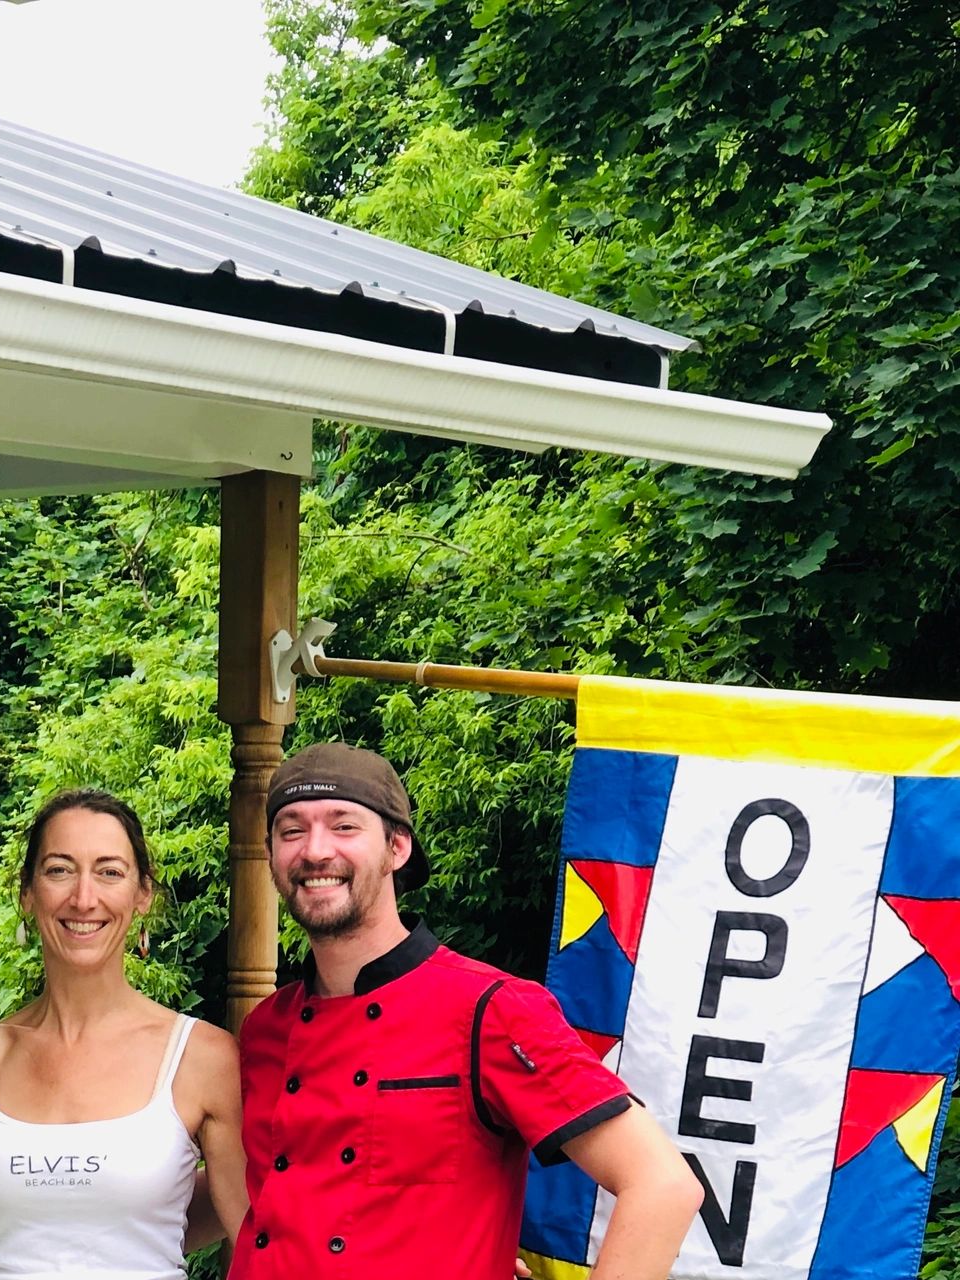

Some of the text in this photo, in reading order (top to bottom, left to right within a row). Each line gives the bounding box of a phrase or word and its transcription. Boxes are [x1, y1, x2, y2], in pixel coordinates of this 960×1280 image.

[678, 797, 811, 1268] OPEN
[25, 1178, 92, 1187] BEACH BAR
